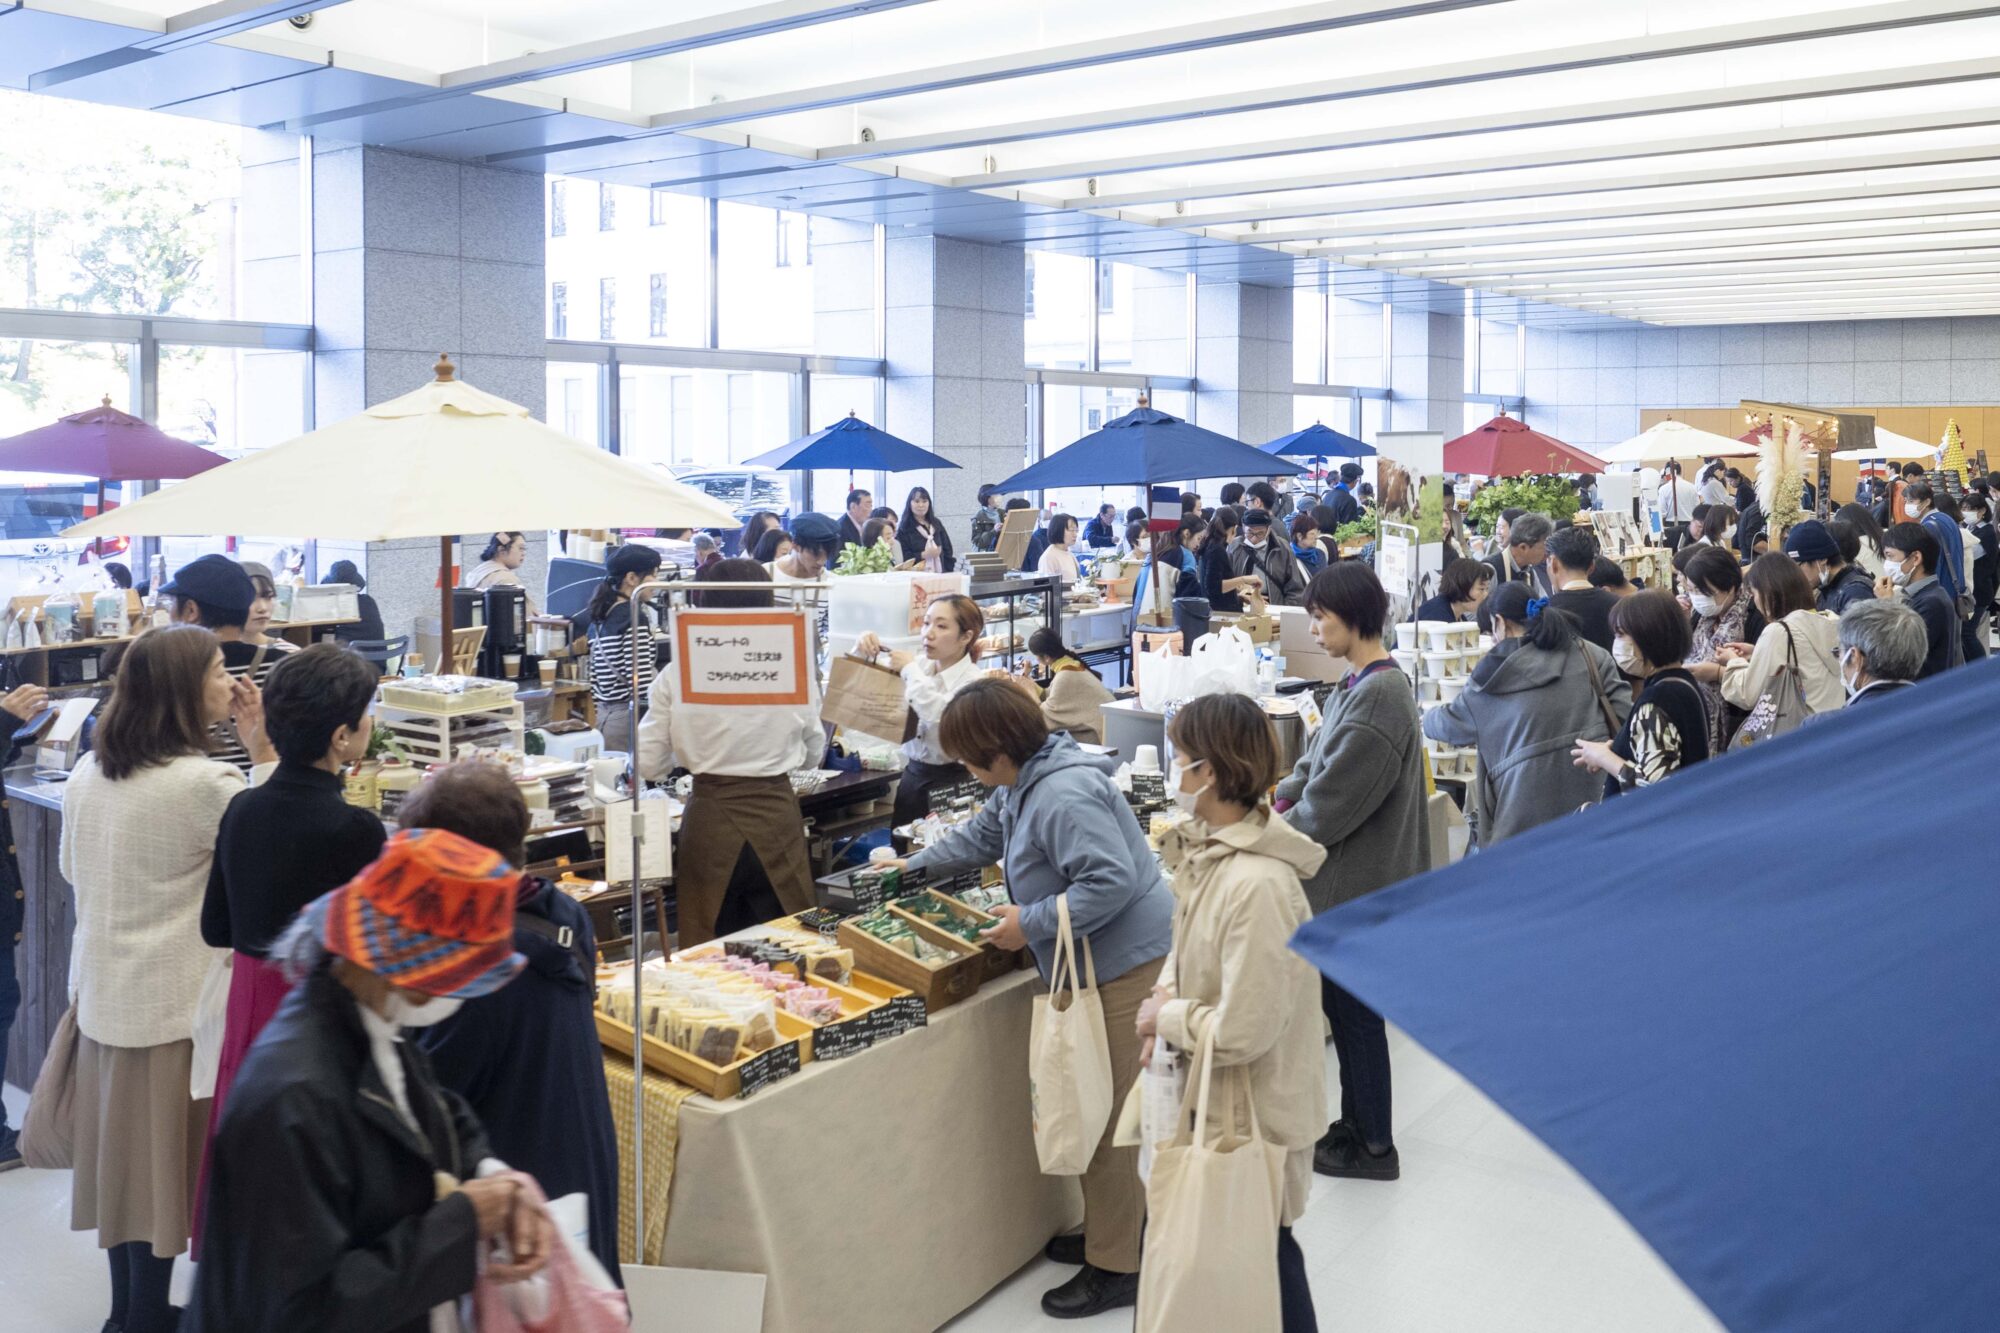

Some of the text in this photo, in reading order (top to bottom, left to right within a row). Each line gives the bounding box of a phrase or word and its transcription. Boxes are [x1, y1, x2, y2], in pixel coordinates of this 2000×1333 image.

[695, 637, 750, 647] チョコレートの
[744, 651, 782, 662] ご注文は
[707, 671, 779, 681] こちらからどうぞ
